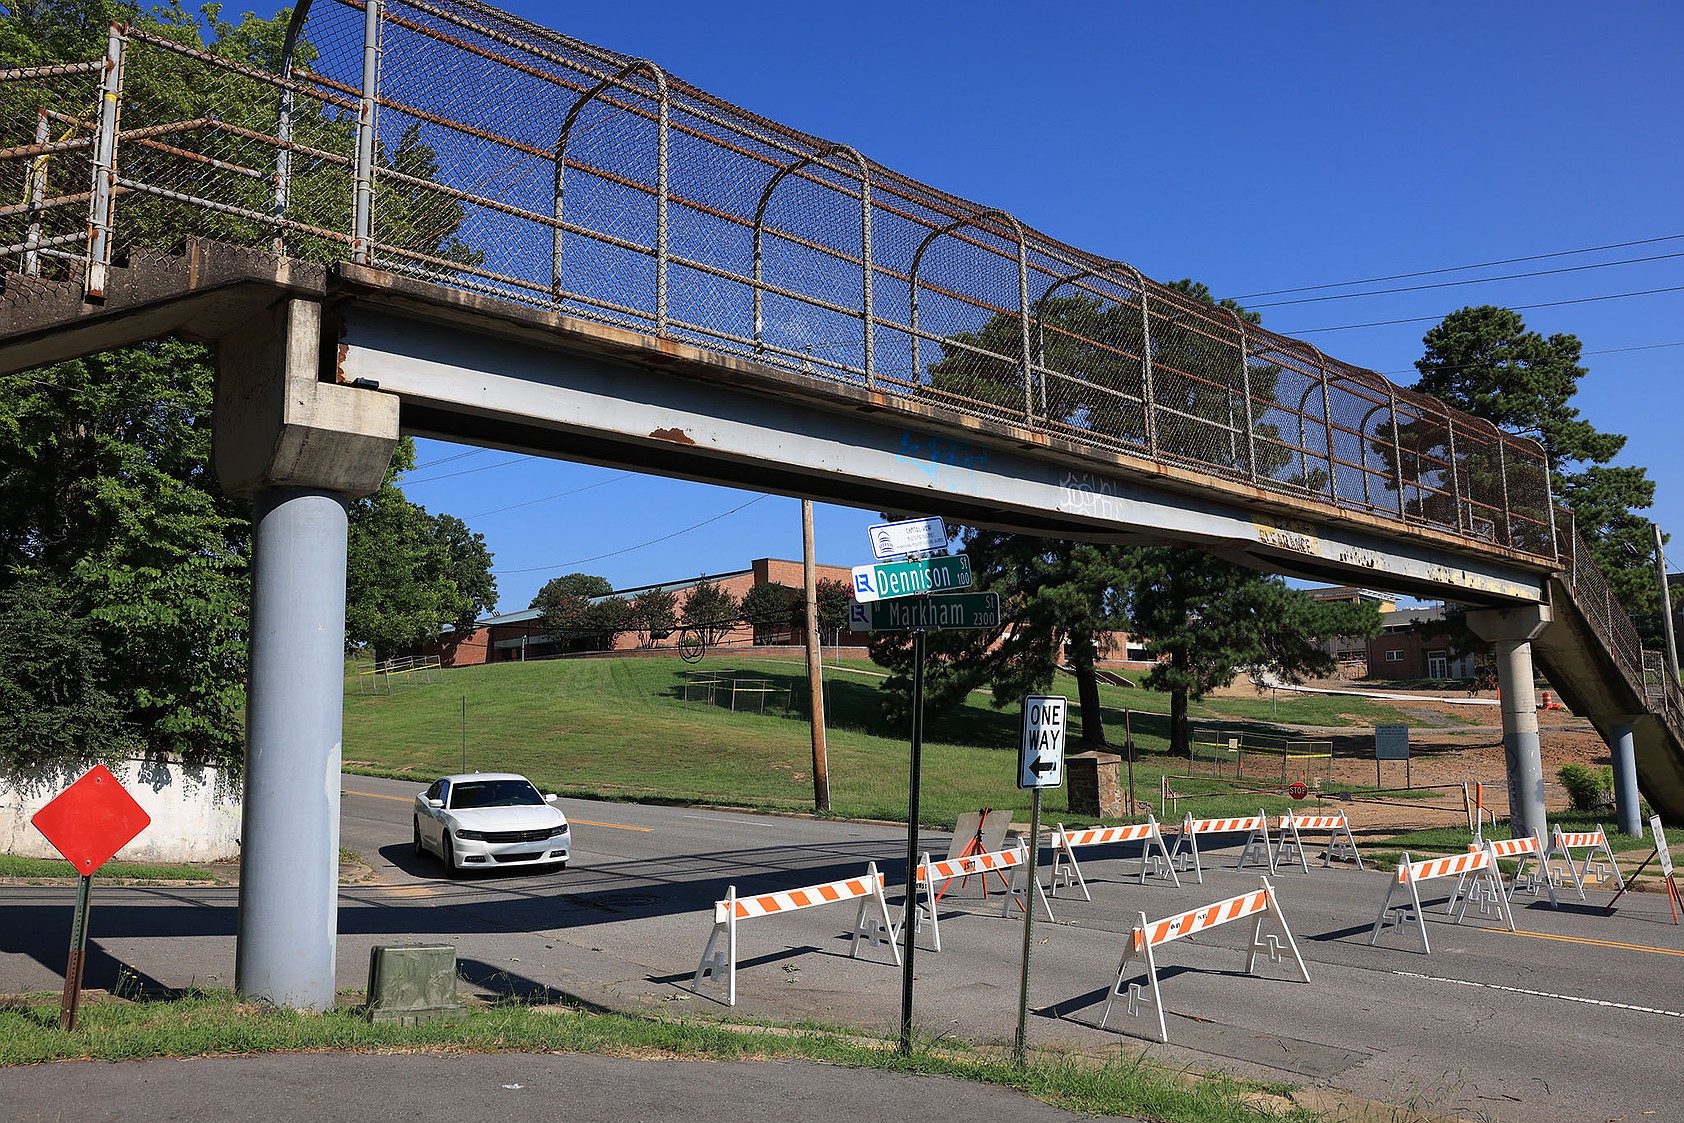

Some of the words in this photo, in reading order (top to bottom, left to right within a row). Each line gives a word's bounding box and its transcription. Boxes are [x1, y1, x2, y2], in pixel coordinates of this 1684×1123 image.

[960, 556, 968, 569] St
[877, 562, 951, 595] Dennison
[957, 572, 969, 585] 100
[986, 596, 994, 609] St
[873, 601, 881, 613] W
[889, 599, 964, 625] Markham
[973, 612, 995, 625] 2300
[1030, 704, 1061, 725] ONE
[1029, 729, 1060, 750] WAY
[1289, 786, 1307, 795] STOP
